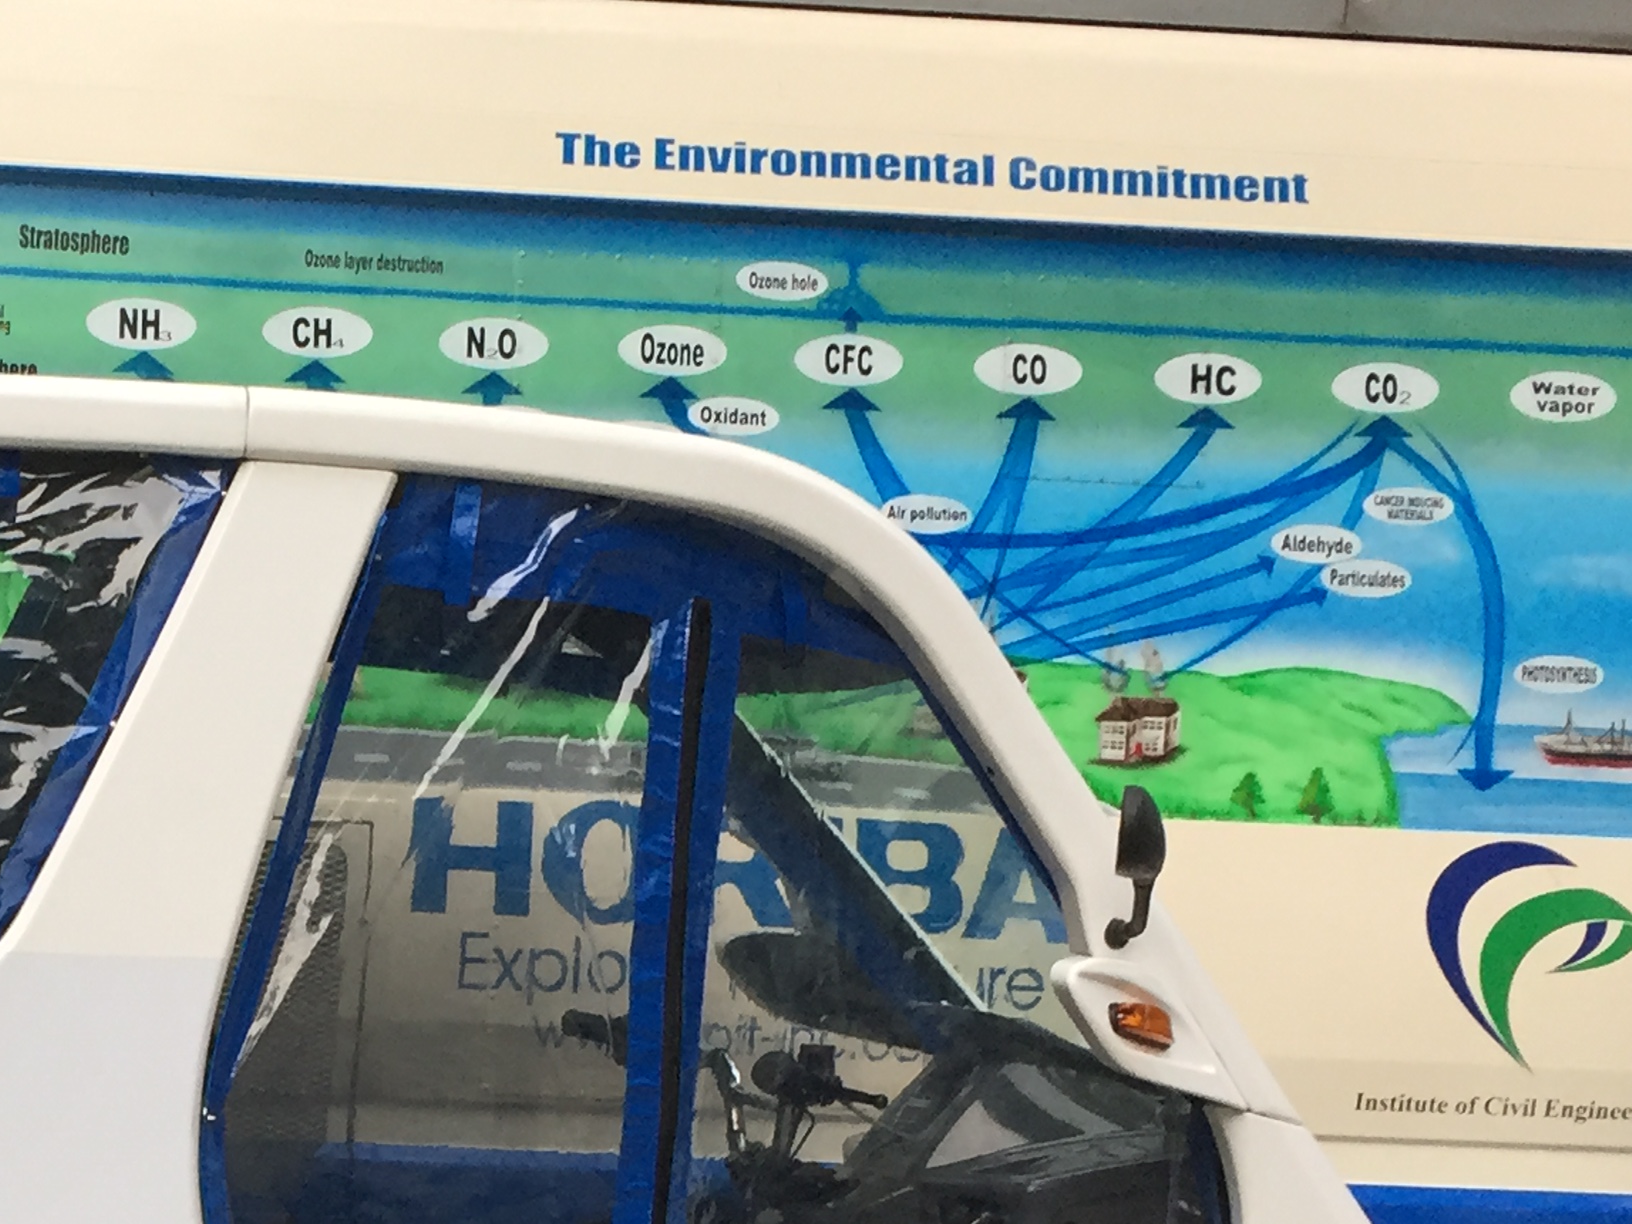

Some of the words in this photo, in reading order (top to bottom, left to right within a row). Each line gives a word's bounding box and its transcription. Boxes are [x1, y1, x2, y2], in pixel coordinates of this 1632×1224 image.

[555, 132, 641, 169] The
[654, 137, 995, 188] Environmental
[1009, 155, 1310, 204] Commitment
[19, 223, 129, 256] Stratosphere
[305, 248, 341, 269] Ozone
[344, 251, 373, 275] layer
[376, 253, 444, 274] destruction
[749, 271, 788, 290] Ozone
[791, 273, 818, 291] hole
[640, 333, 704, 368] Ozone
[824, 344, 873, 377] CFC
[1012, 355, 1047, 386] CO
[1190, 363, 1237, 396] HC
[1532, 380, 1600, 398] Water
[700, 405, 768, 428] Oxidant
[1536, 398, 1595, 417] vapor
[887, 505, 907, 519] Air
[910, 507, 967, 523] pollution
[1281, 534, 1353, 558] Aldehyde
[1330, 568, 1405, 588] Particulates
[409, 796, 1069, 945] HORBA
[458, 931, 628, 1005] Explo
[1355, 1092, 1448, 1114] Institute
[1454, 1096, 1480, 1115] of
[1483, 1096, 1537, 1118] Civil
